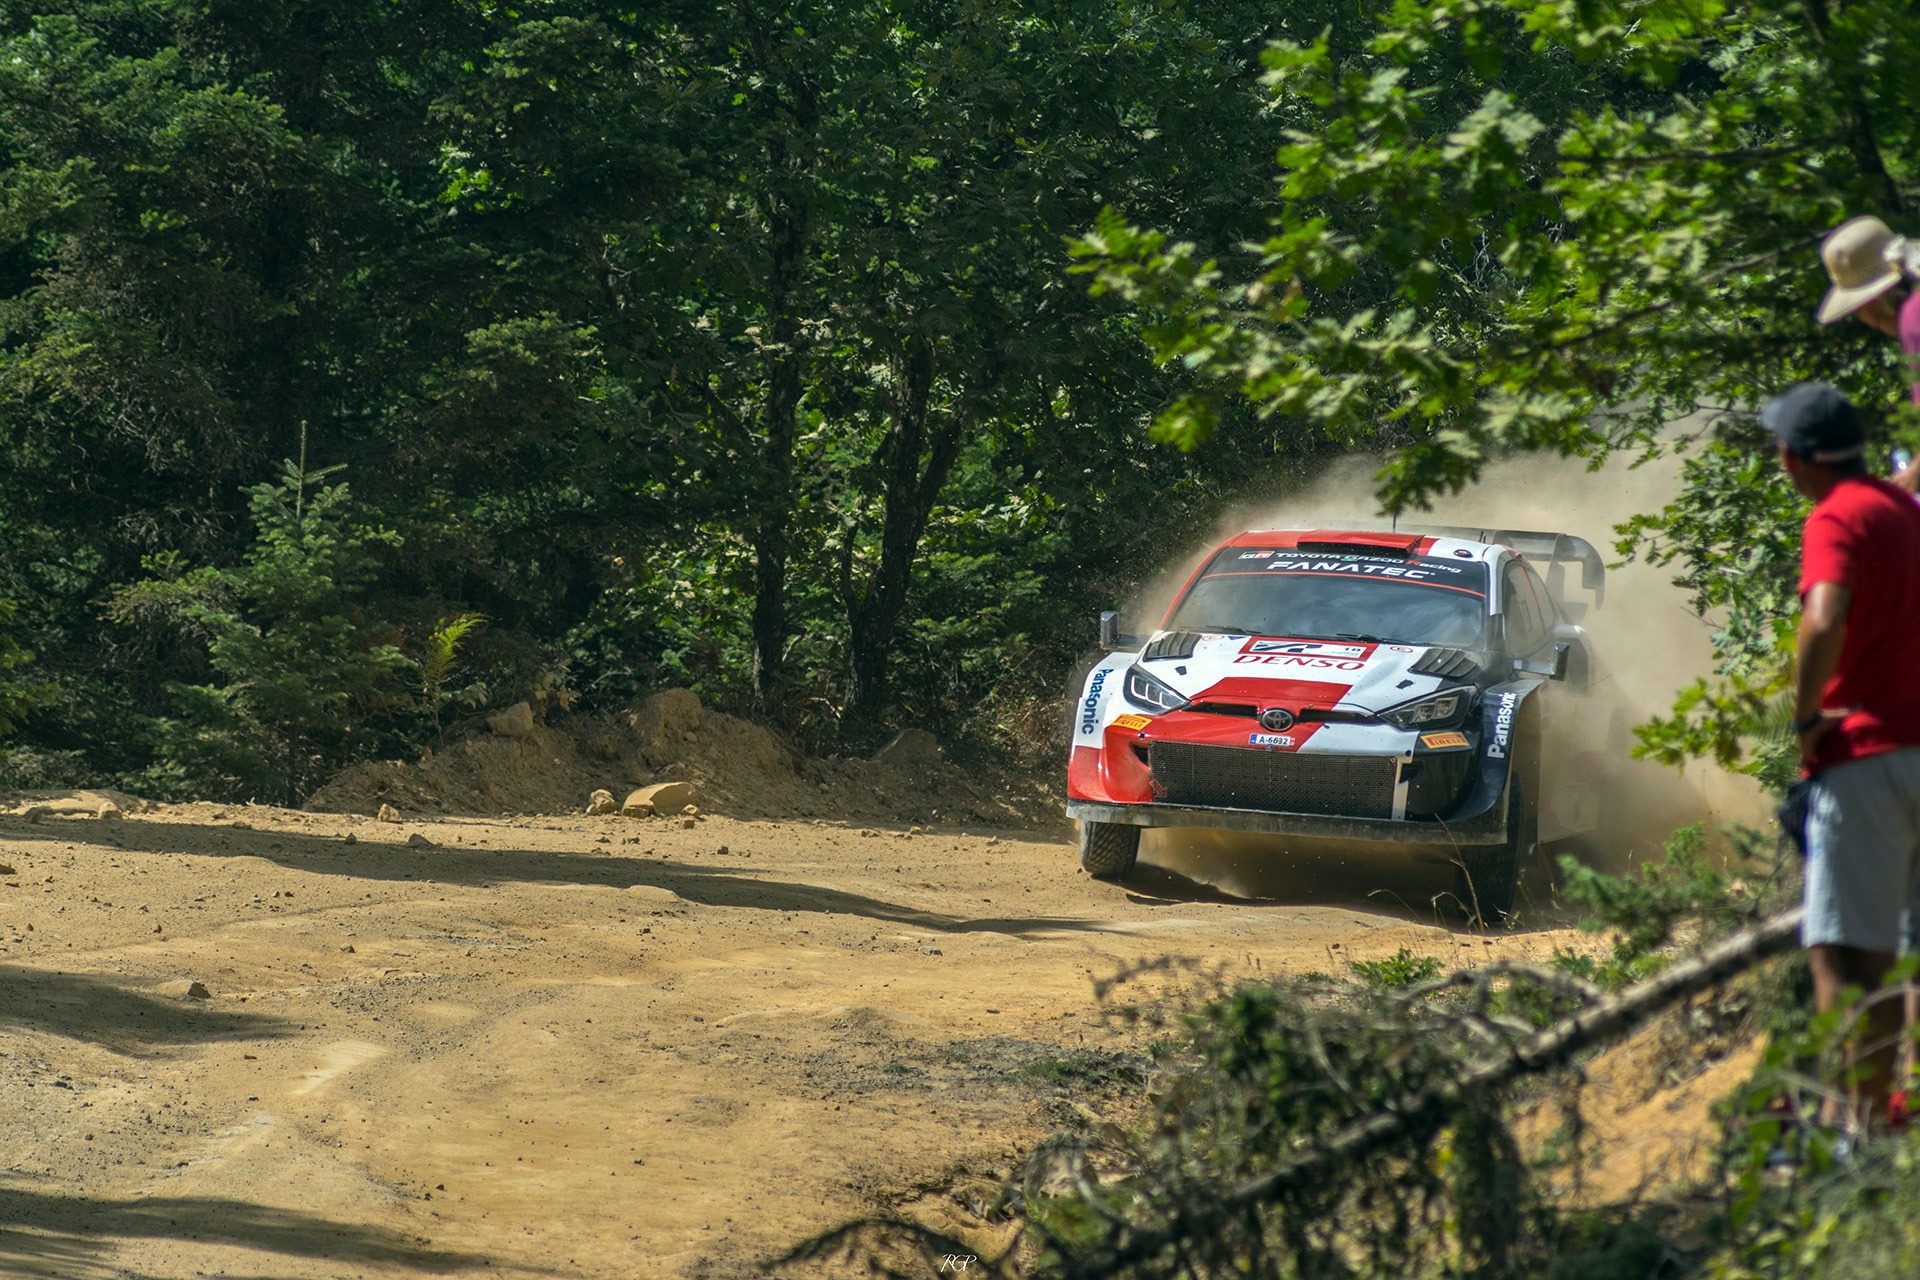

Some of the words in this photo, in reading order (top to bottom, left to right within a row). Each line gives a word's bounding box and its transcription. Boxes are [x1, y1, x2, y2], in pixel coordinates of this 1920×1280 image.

[1238, 551, 1275, 559] GR
[1405, 560, 1462, 574] Racing
[1266, 561, 1430, 579] FANATEC
[1232, 655, 1365, 671] DENSO
[1082, 668, 1114, 735] Panasonic
[1114, 715, 1147, 728] PIRELLI
[1426, 734, 1467, 746] PIRELLI
